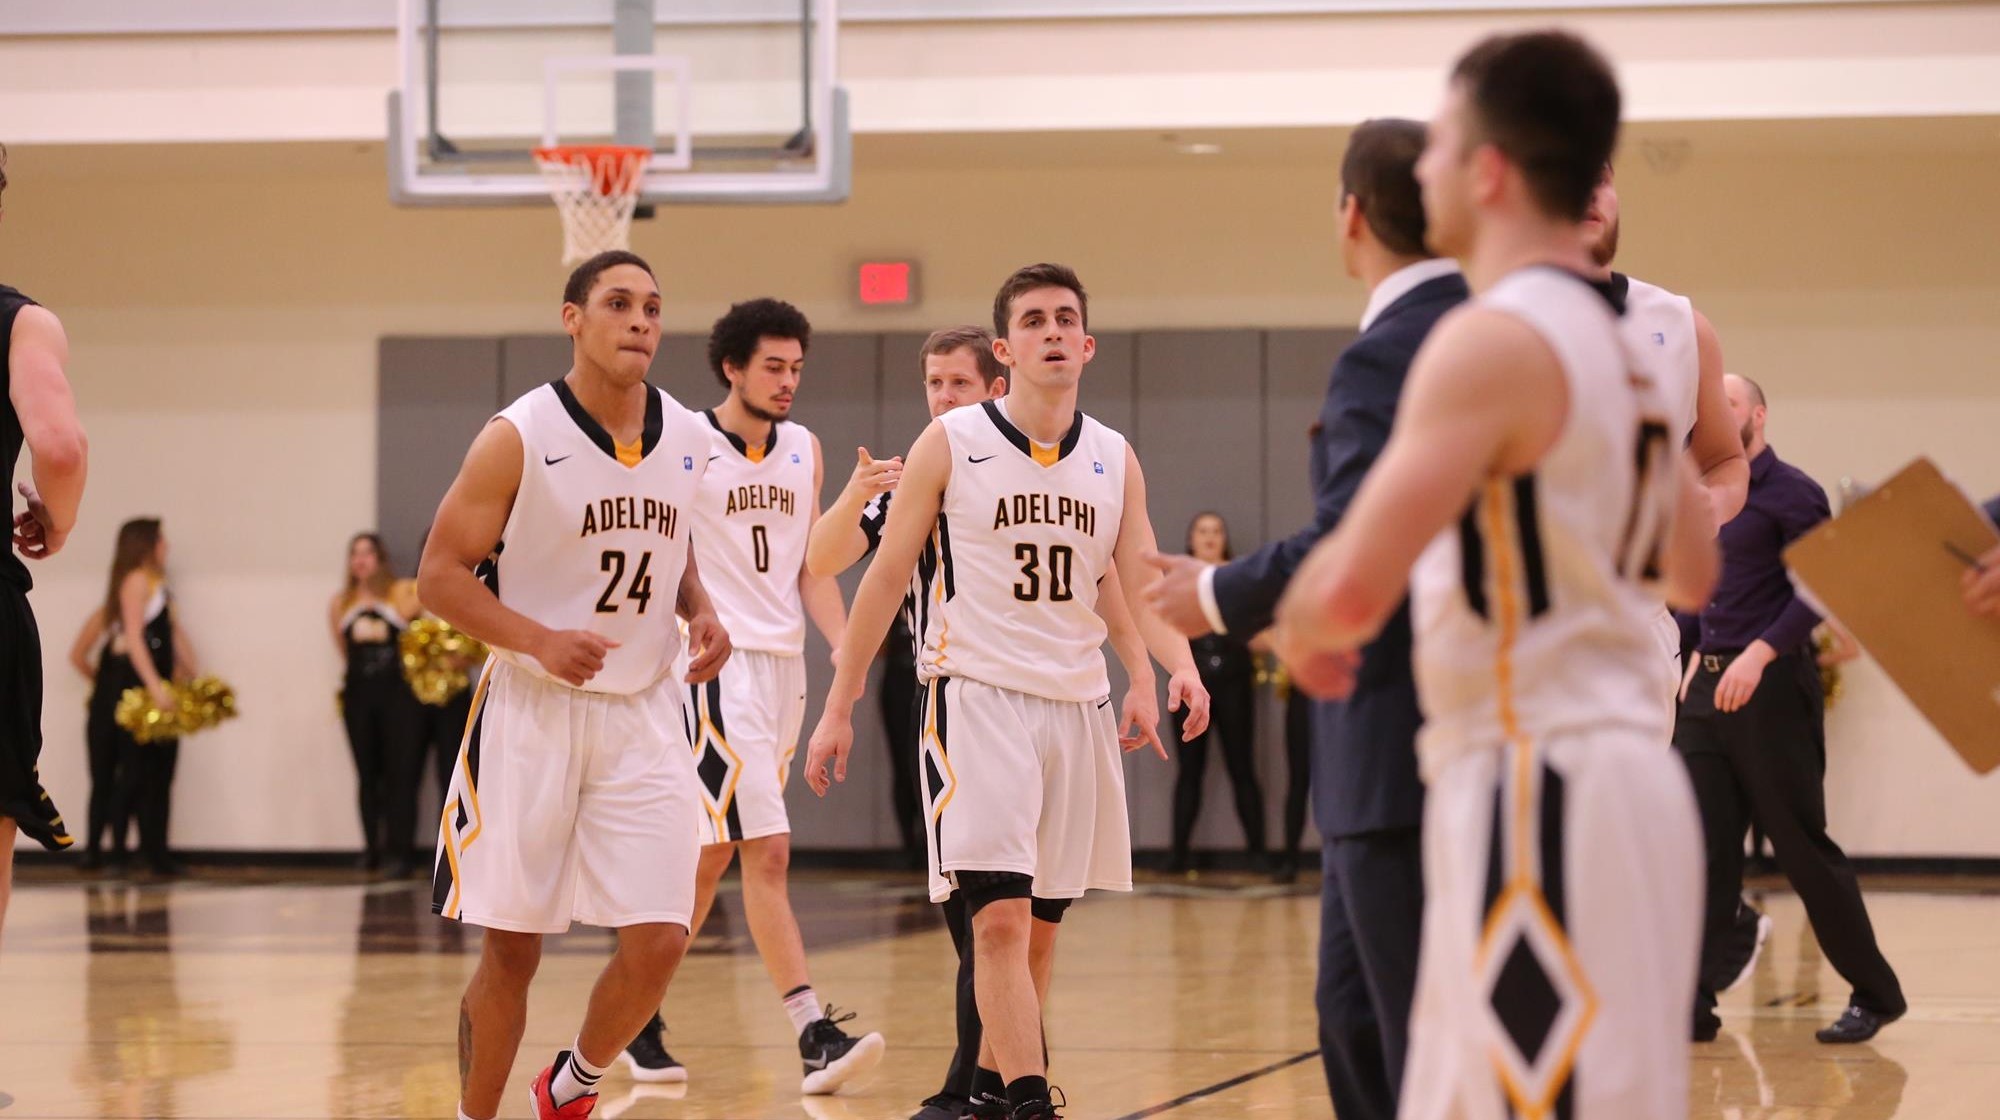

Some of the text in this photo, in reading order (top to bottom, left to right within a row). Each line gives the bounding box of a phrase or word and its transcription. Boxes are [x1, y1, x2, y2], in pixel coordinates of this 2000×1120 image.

[580, 496, 677, 540] ADELPHI
[725, 484, 795, 516] ADELPHI
[993, 493, 1095, 538] ADELPHI
[751, 524, 769, 573] 0
[1014, 542, 1073, 602] 30
[595, 549, 652, 614] 24
